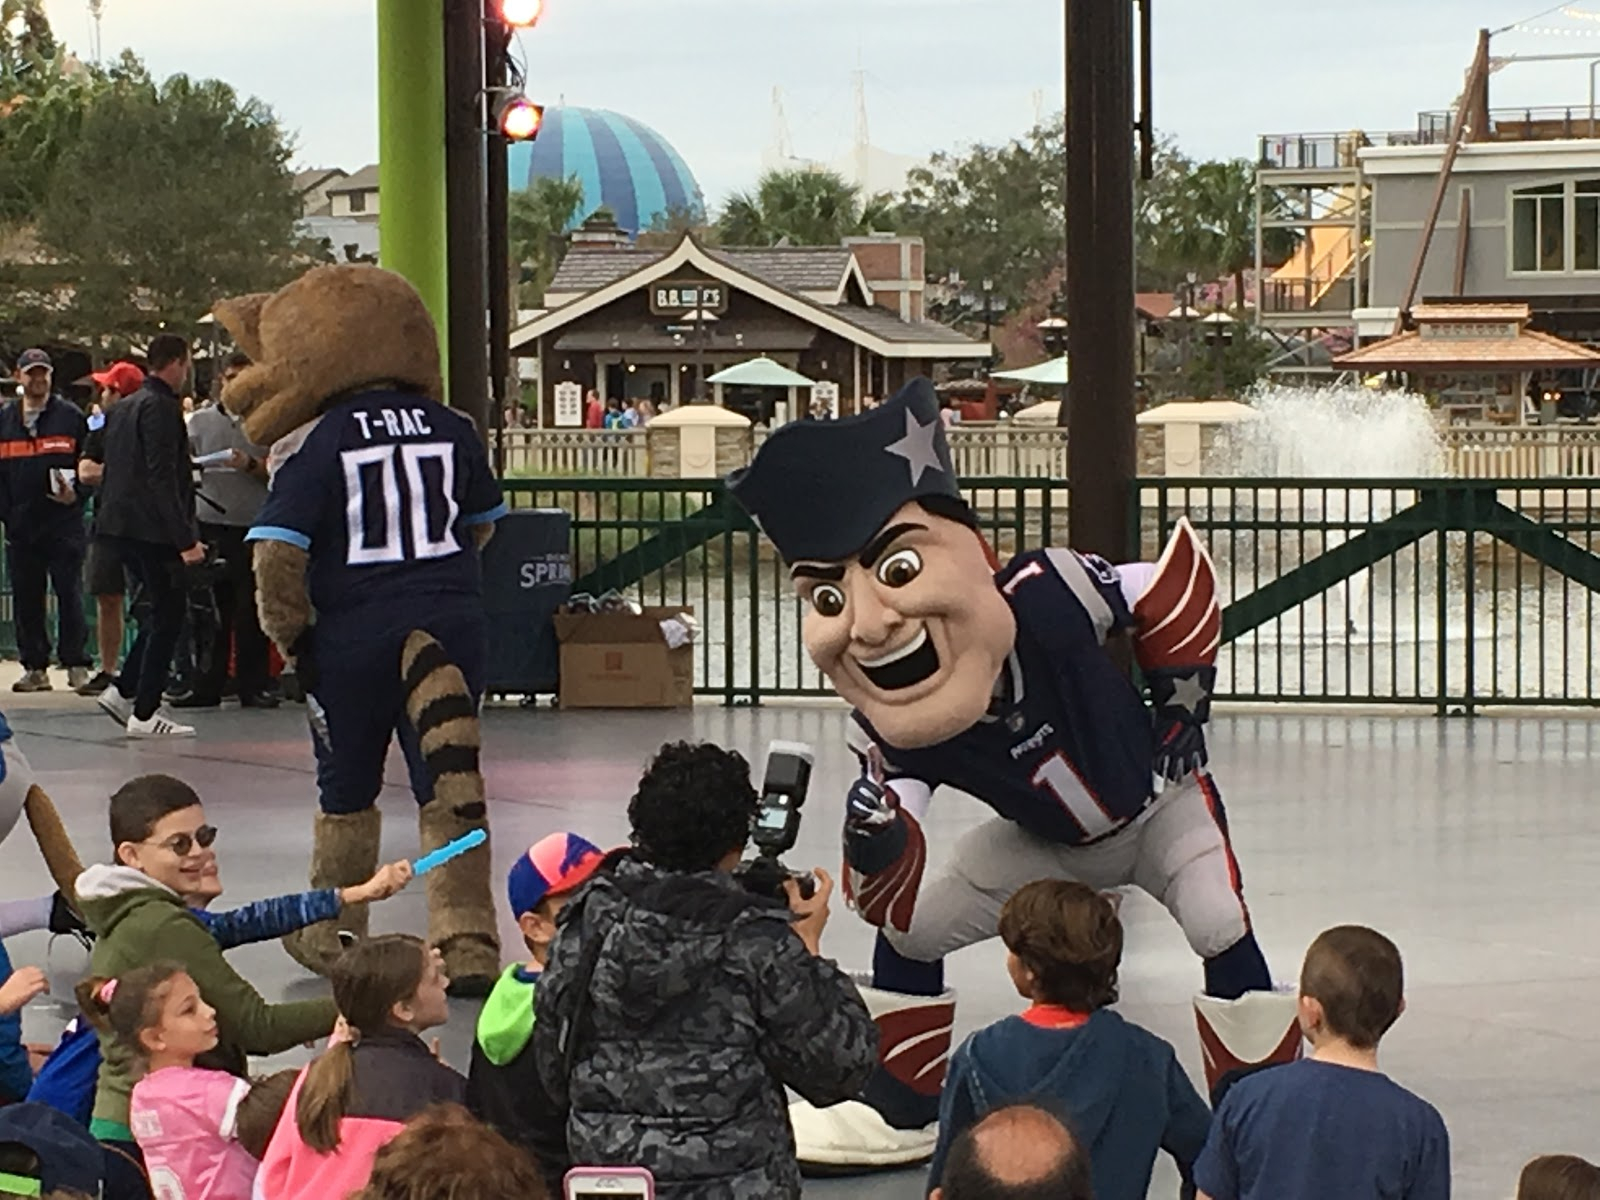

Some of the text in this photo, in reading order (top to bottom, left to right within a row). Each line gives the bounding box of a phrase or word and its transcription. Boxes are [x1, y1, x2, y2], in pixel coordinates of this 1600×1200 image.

[352, 408, 432, 439] T-RAC
[340, 442, 463, 565] 00
[1031, 751, 1130, 841] 1
